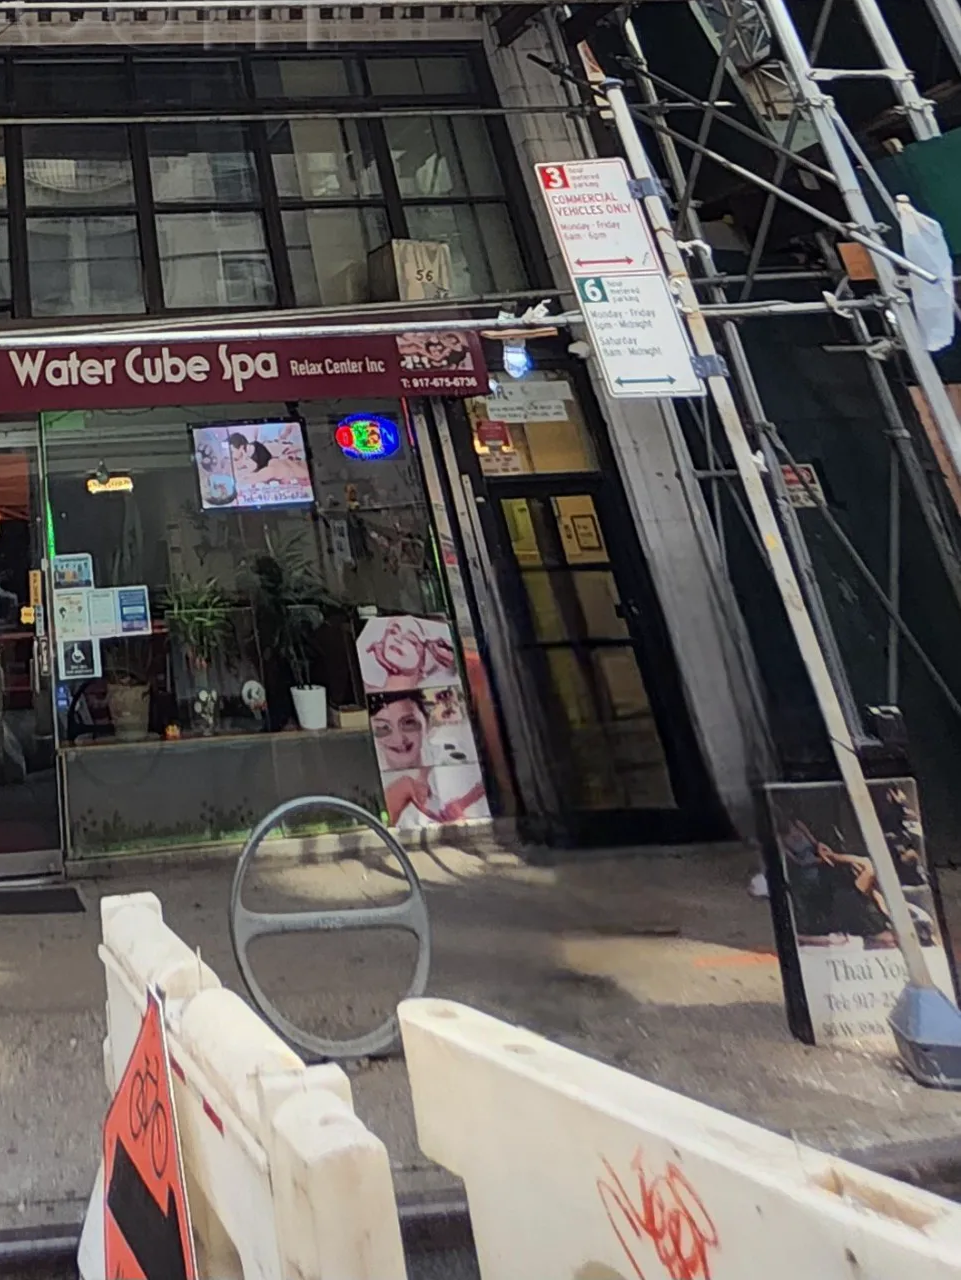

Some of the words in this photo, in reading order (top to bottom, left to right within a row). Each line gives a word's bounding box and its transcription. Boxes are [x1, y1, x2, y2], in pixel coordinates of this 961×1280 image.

[548, 168, 563, 188] 3
[552, 193, 618, 205] COMMERCIAL
[556, 205, 604, 217] VEHICLES
[606, 203, 633, 214] ONLY
[560, 222, 590, 231] Monday
[596, 220, 621, 231] Friday
[415, 269, 435, 282] 56
[584, 280, 600, 303] 6
[590, 309, 623, 320] Monday
[630, 307, 656, 319] Friday
[599, 335, 638, 347] Saturday
[9, 350, 117, 387] Water
[124, 347, 211, 384] Cube
[219, 343, 279, 392] Spa
[290, 358, 323, 376] Relax
[325, 356, 364, 375] Center
[365, 356, 386, 374] Inc
[401, 378, 411, 388] T:
[824, 957, 874, 982] Thai
